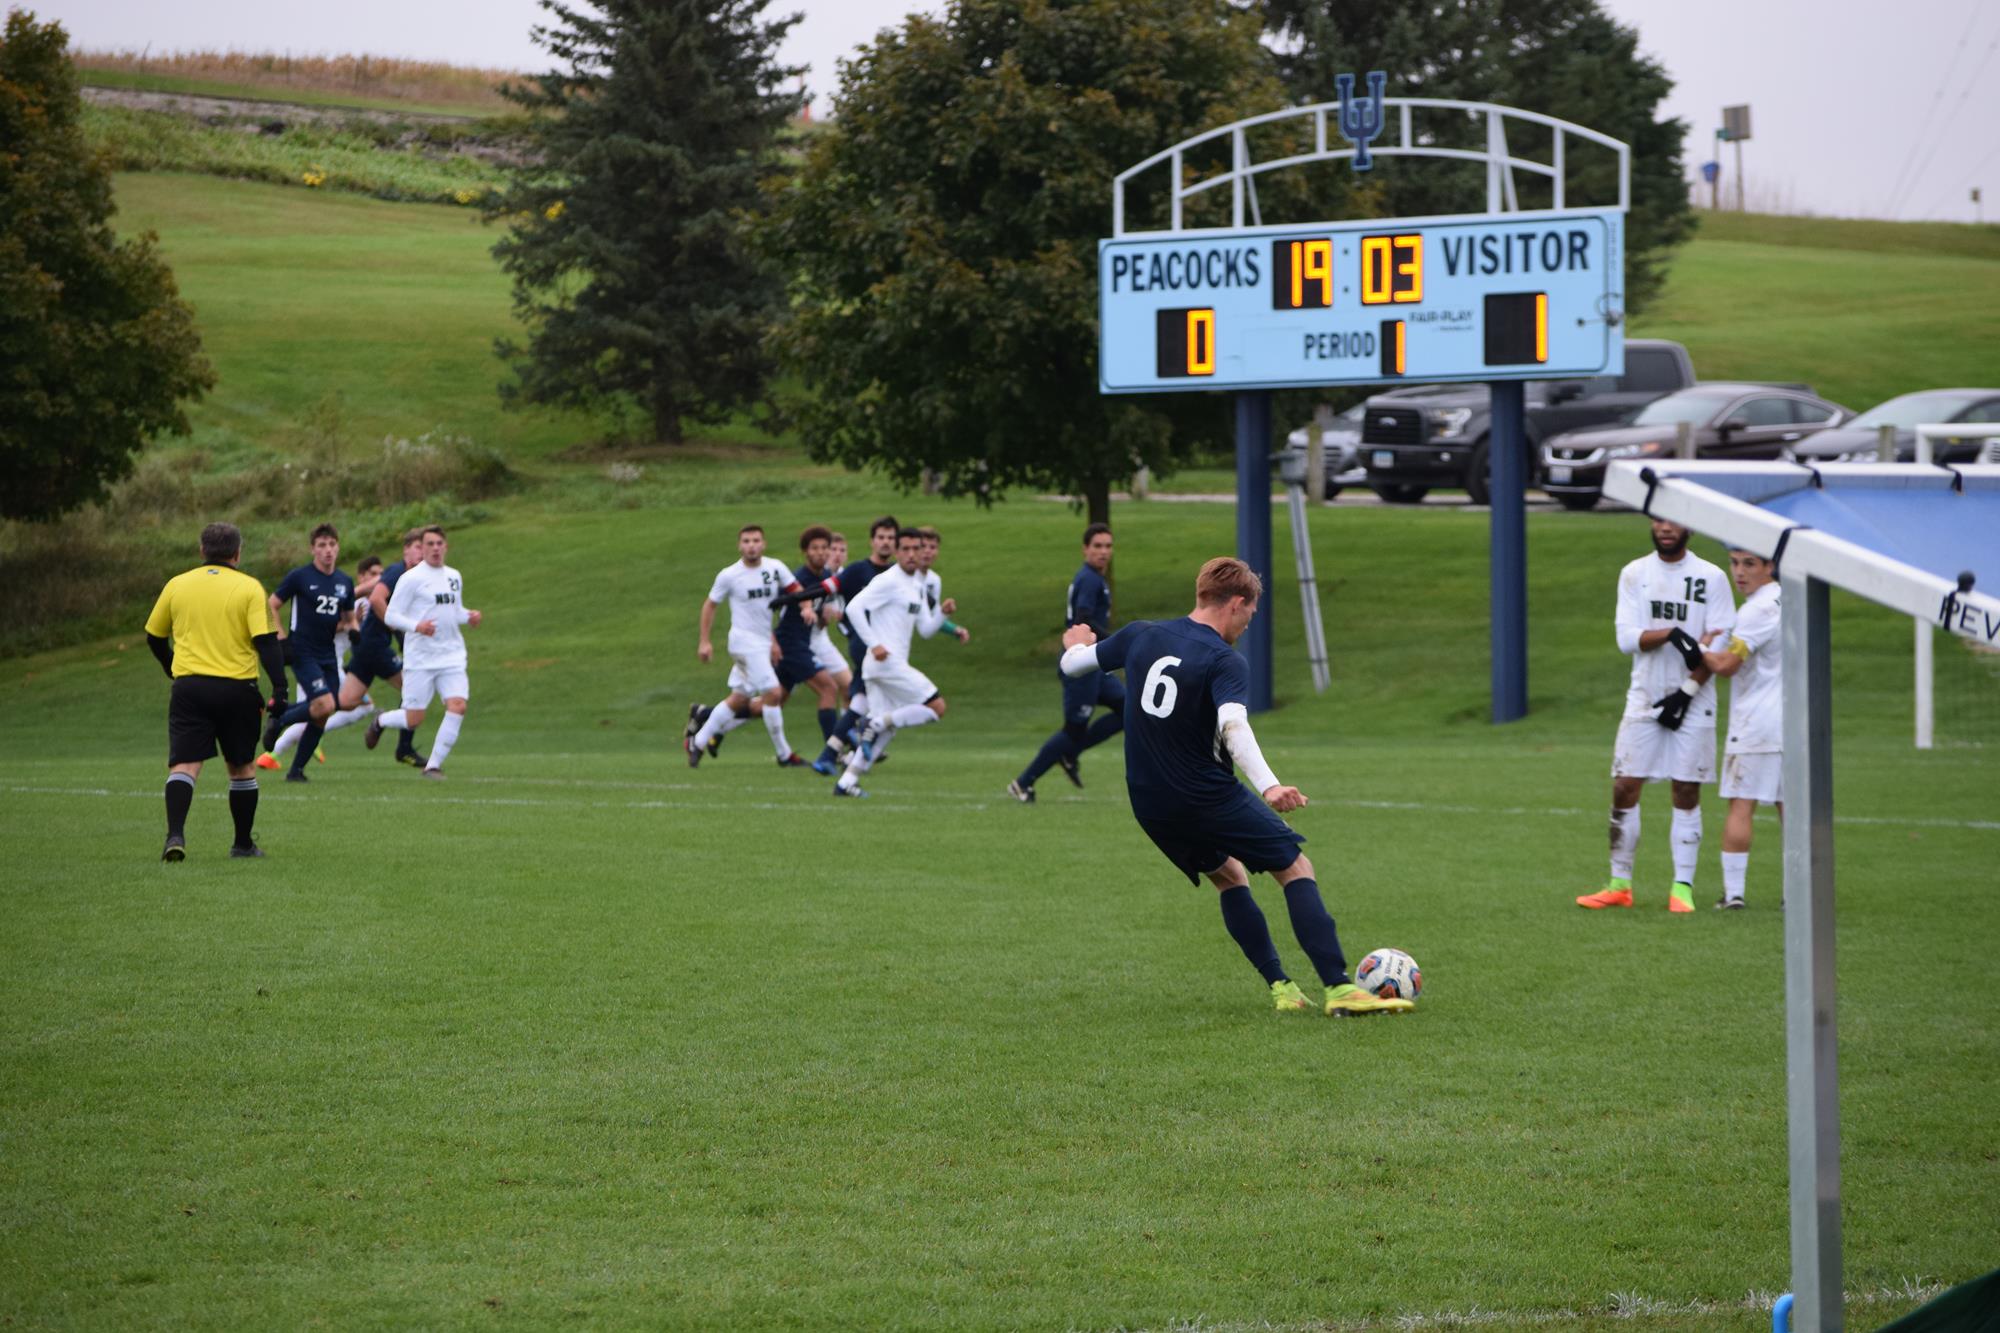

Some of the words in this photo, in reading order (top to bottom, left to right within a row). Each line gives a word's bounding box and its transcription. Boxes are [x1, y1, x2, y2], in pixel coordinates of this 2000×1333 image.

[1112, 248, 1261, 293] PEACOCKS
[1441, 230, 1590, 277] VISITOR
[1187, 309, 1216, 376] 0
[1304, 331, 1376, 360] PERIOD
[1395, 321, 1406, 375] 1
[1536, 293, 1549, 363] 1
[762, 569, 780, 585] 24
[1684, 576, 1707, 604] 12
[316, 594, 340, 616] 23
[1141, 655, 1182, 719] 6
